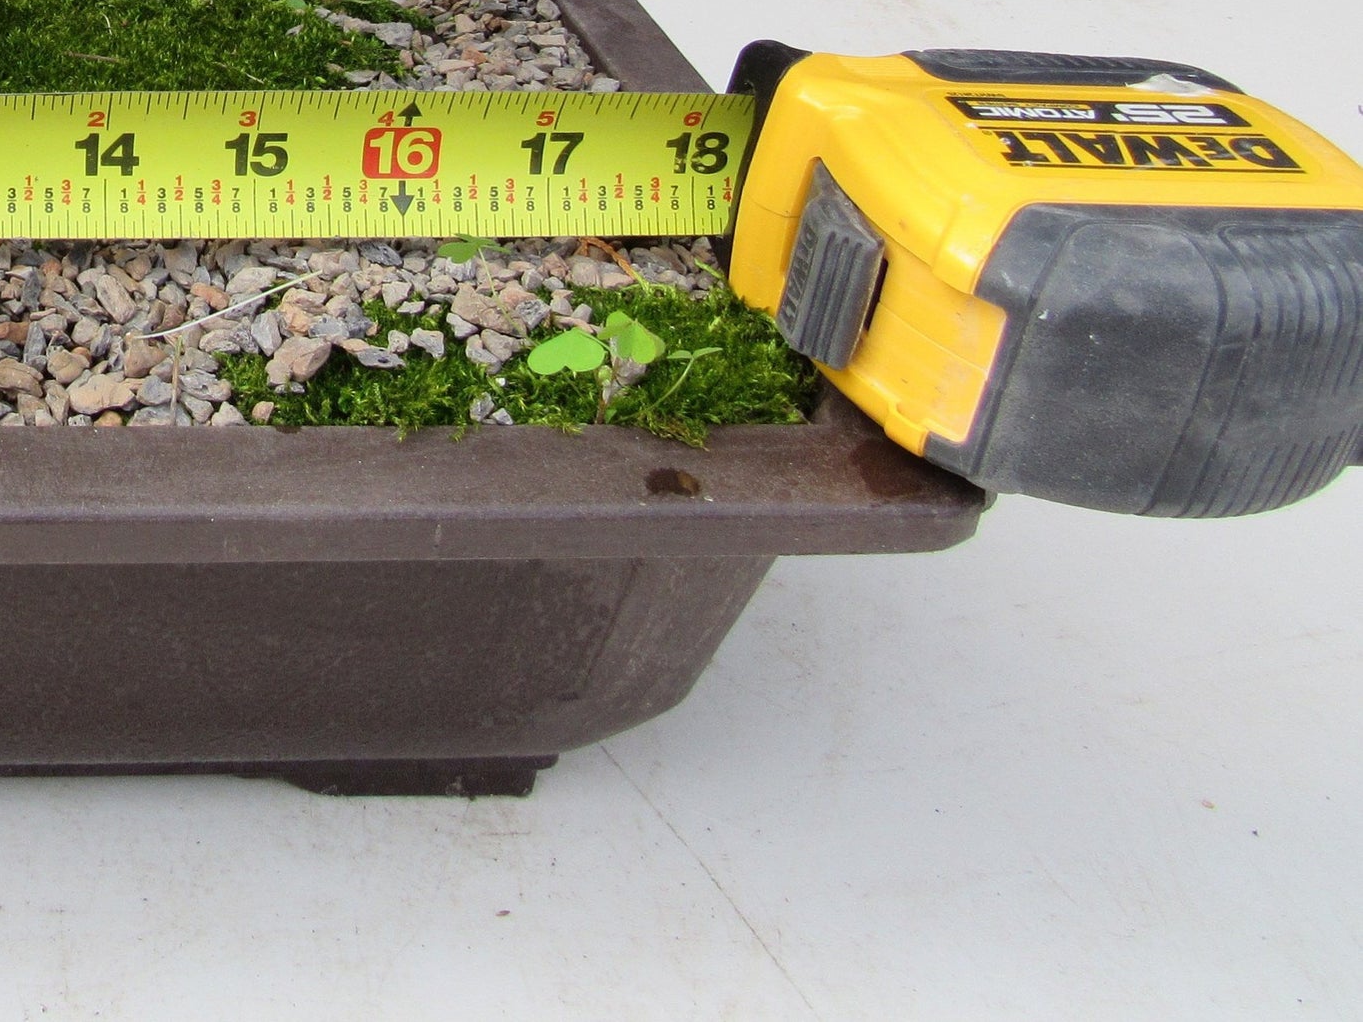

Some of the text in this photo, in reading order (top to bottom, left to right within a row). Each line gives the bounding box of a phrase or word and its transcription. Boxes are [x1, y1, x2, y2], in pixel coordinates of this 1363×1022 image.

[88, 111, 106, 127] 2
[238, 111, 257, 127] 3
[377, 111, 395, 126] 4
[536, 111, 555, 126] 5
[683, 111, 703, 126] 6
[972, 106, 1095, 119] ATOMIC
[75, 133, 140, 176] 14
[225, 133, 289, 176] 15
[367, 130, 434, 175] 16
[521, 132, 585, 175] 17
[666, 132, 730, 174] 18
